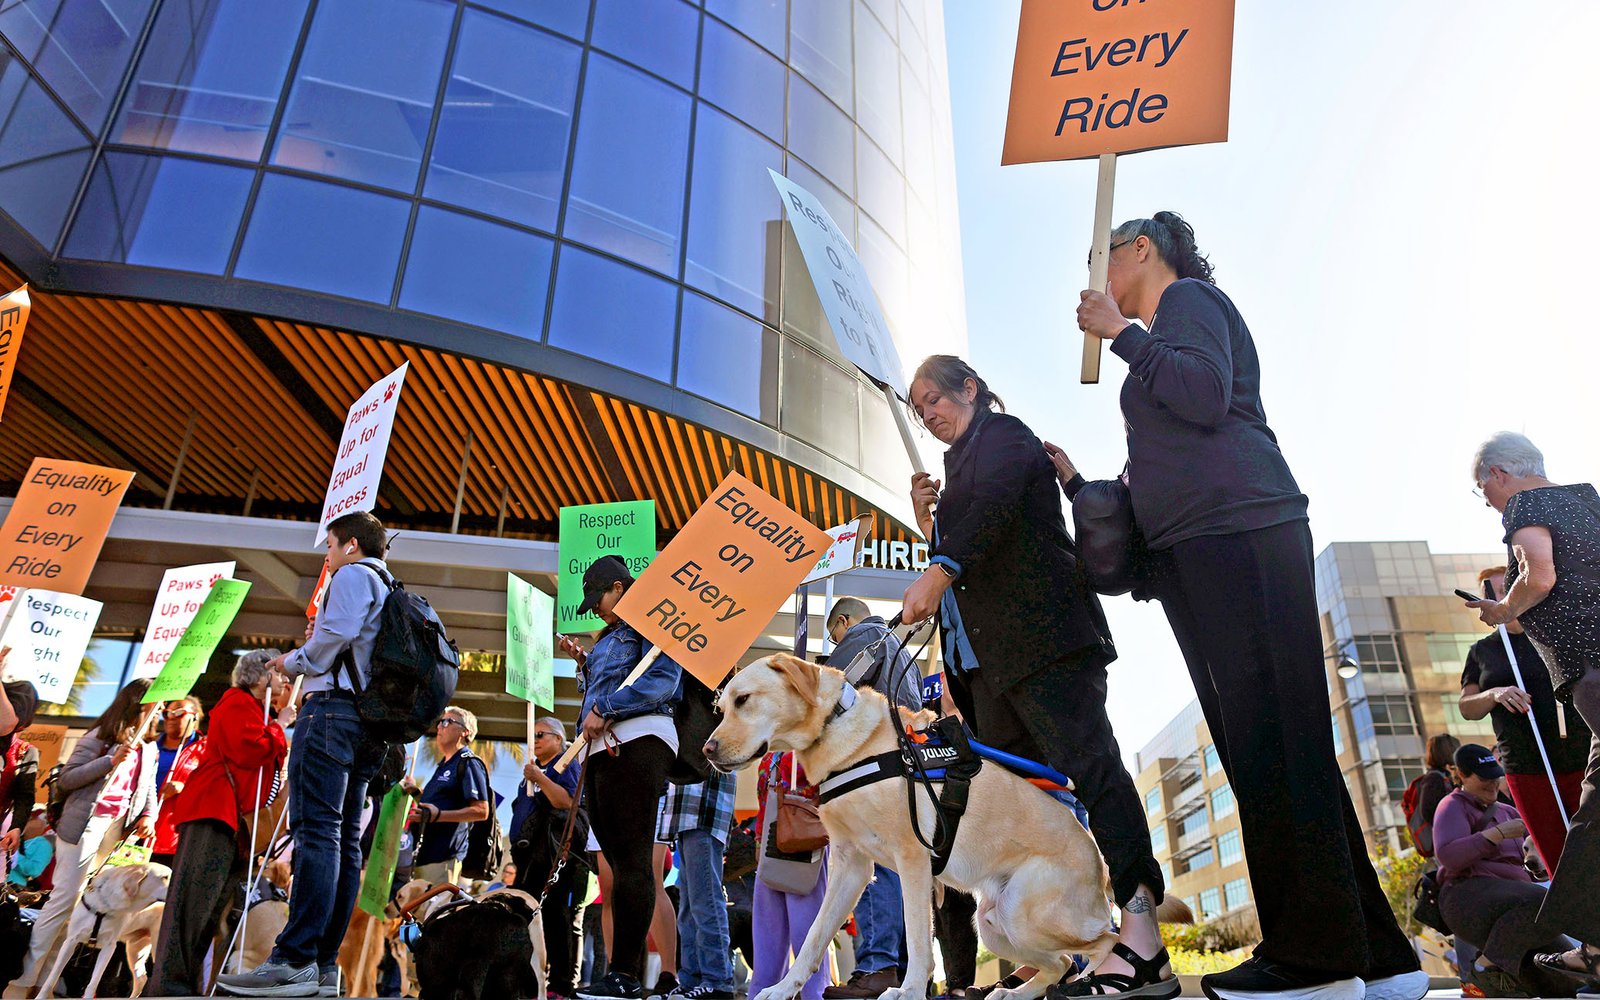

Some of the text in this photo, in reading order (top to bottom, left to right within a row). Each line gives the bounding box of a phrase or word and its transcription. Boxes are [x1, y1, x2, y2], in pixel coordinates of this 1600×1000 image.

[1051, 29, 1189, 77] Every
[1054, 88, 1168, 136] Ride
[840, 317, 862, 347] to
[349, 399, 379, 429] Paws
[341, 423, 379, 460] Up for
[30, 467, 121, 497] Equality
[332, 454, 368, 492] Equal
[47, 502, 76, 517] on
[323, 486, 368, 525] Access
[579, 510, 635, 529] Respect
[15, 525, 83, 552] Every
[714, 486, 815, 563] Equality
[596, 534, 622, 549] Our
[861, 538, 931, 570] HIRD
[6, 556, 61, 578] Ride
[626, 556, 650, 573] ogs
[718, 544, 755, 573] on
[167, 579, 203, 593] Paws
[670, 561, 746, 622] Every
[161, 603, 180, 617] Up
[30, 620, 62, 638] Our
[153, 626, 188, 641] Equa
[646, 598, 708, 652] Ride
[144, 651, 169, 664] Acc
[920, 746, 958, 761] JULIUS
